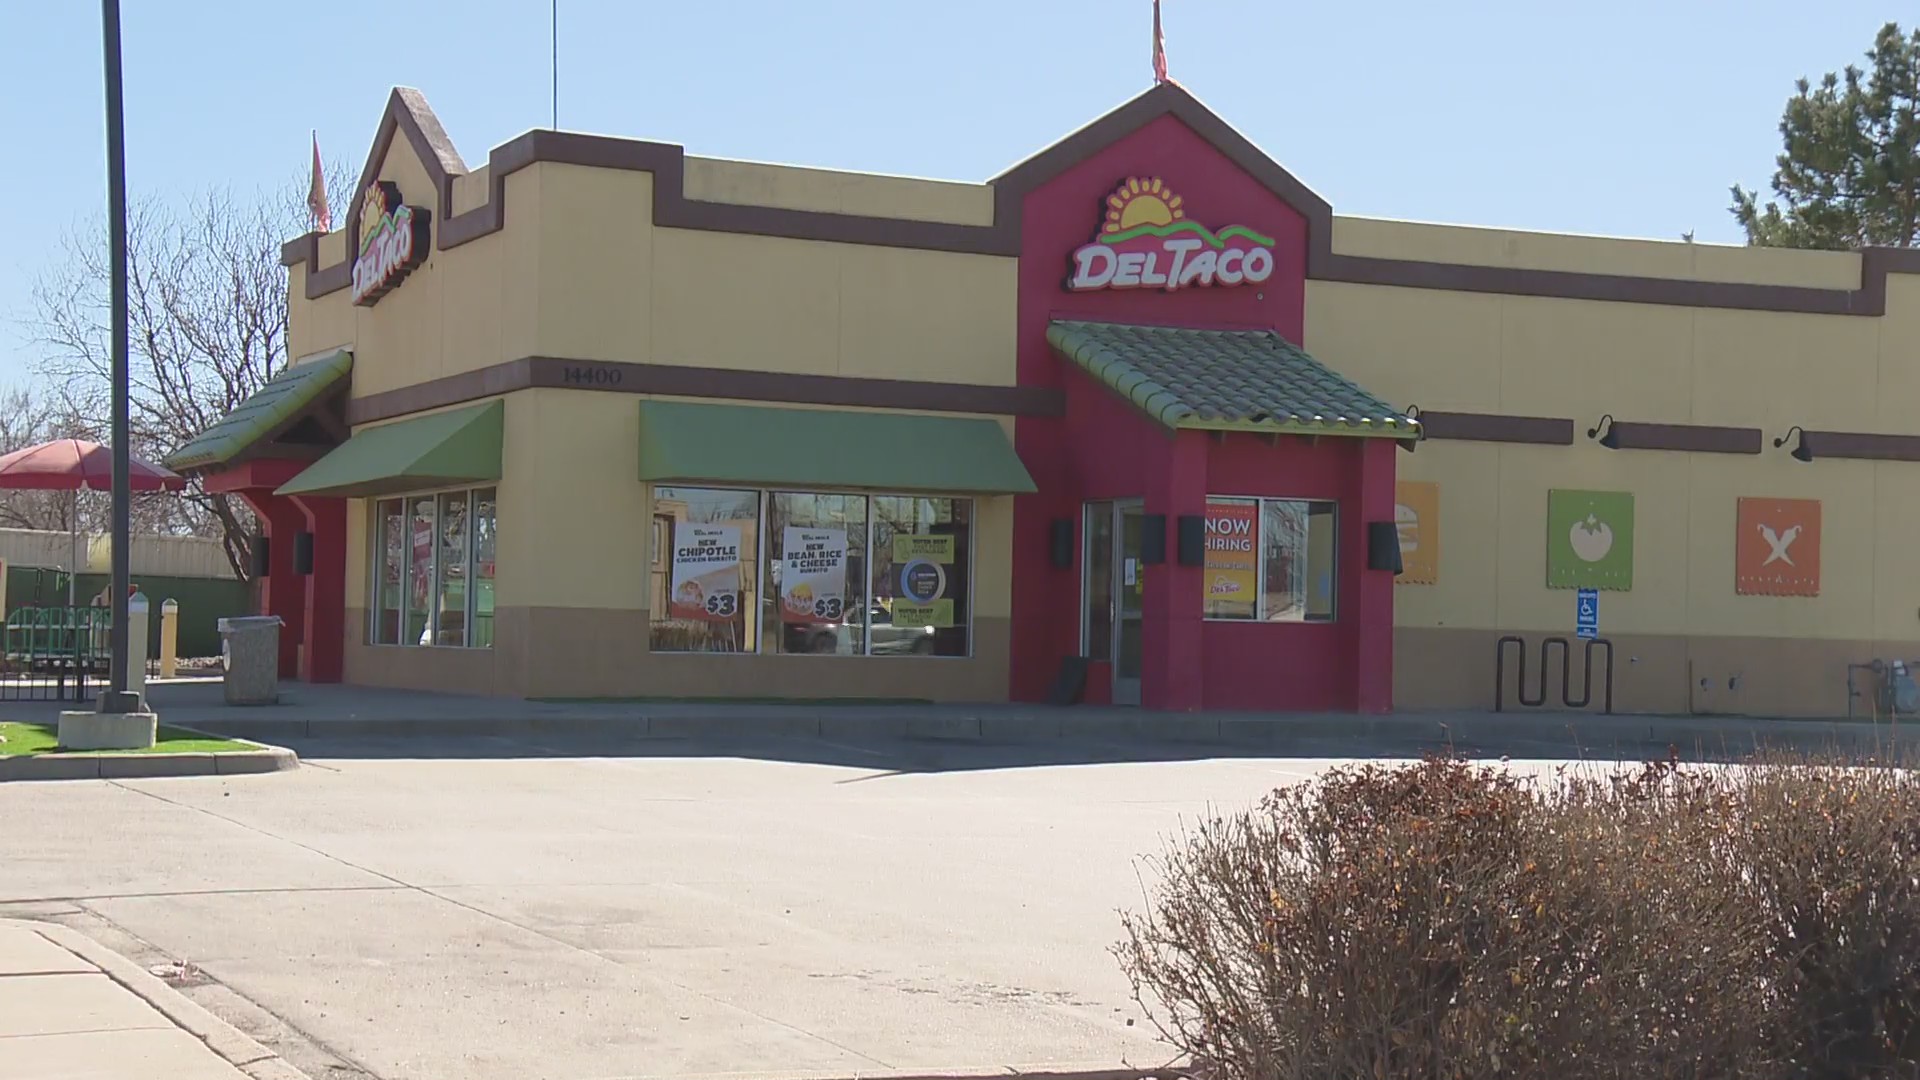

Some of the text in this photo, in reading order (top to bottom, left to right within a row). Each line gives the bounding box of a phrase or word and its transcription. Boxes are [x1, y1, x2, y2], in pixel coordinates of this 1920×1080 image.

[564, 367, 622, 385] 14400
[1205, 517, 1251, 535] NOW
[678, 546, 736, 557] CHIPOTLE
[805, 543, 825, 551] NEW
[819, 550, 842, 559] RICE
[800, 558, 838, 568] CHEESE
[707, 594, 735, 615] $3
[815, 598, 842, 618] $3
